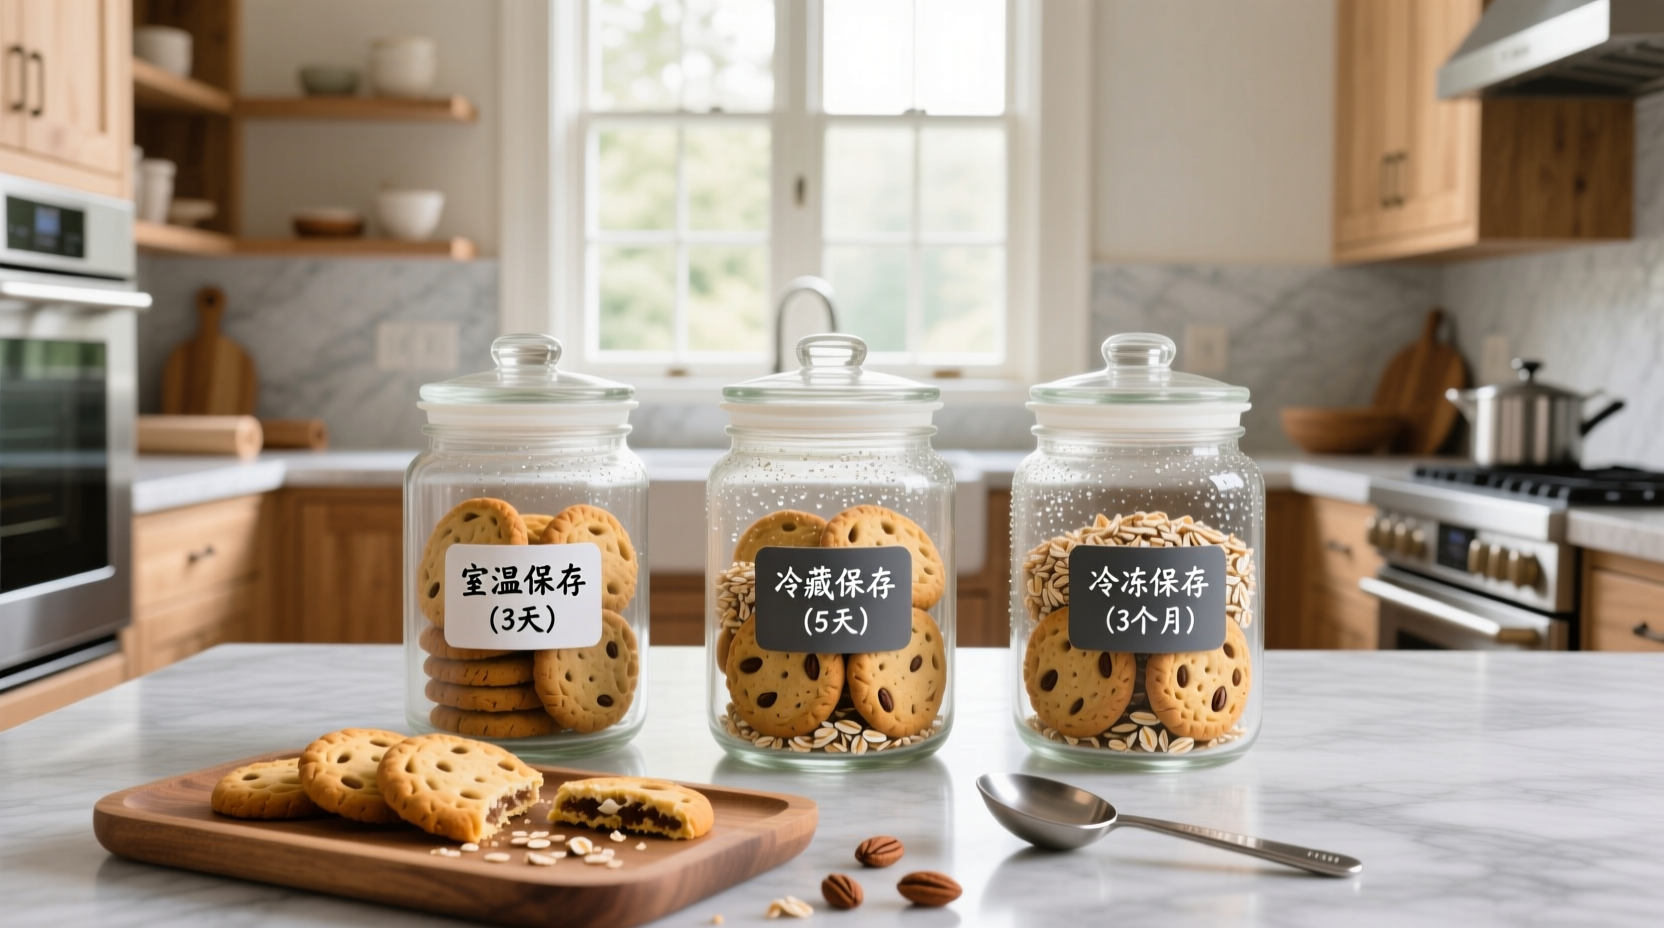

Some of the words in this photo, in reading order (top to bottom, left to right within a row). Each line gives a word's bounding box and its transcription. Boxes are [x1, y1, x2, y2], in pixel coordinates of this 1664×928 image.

[461, 562, 587, 597] 室温保存
[774, 565, 896, 599] 冷藏保存
[1088, 565, 1210, 598] 冷冻保存
